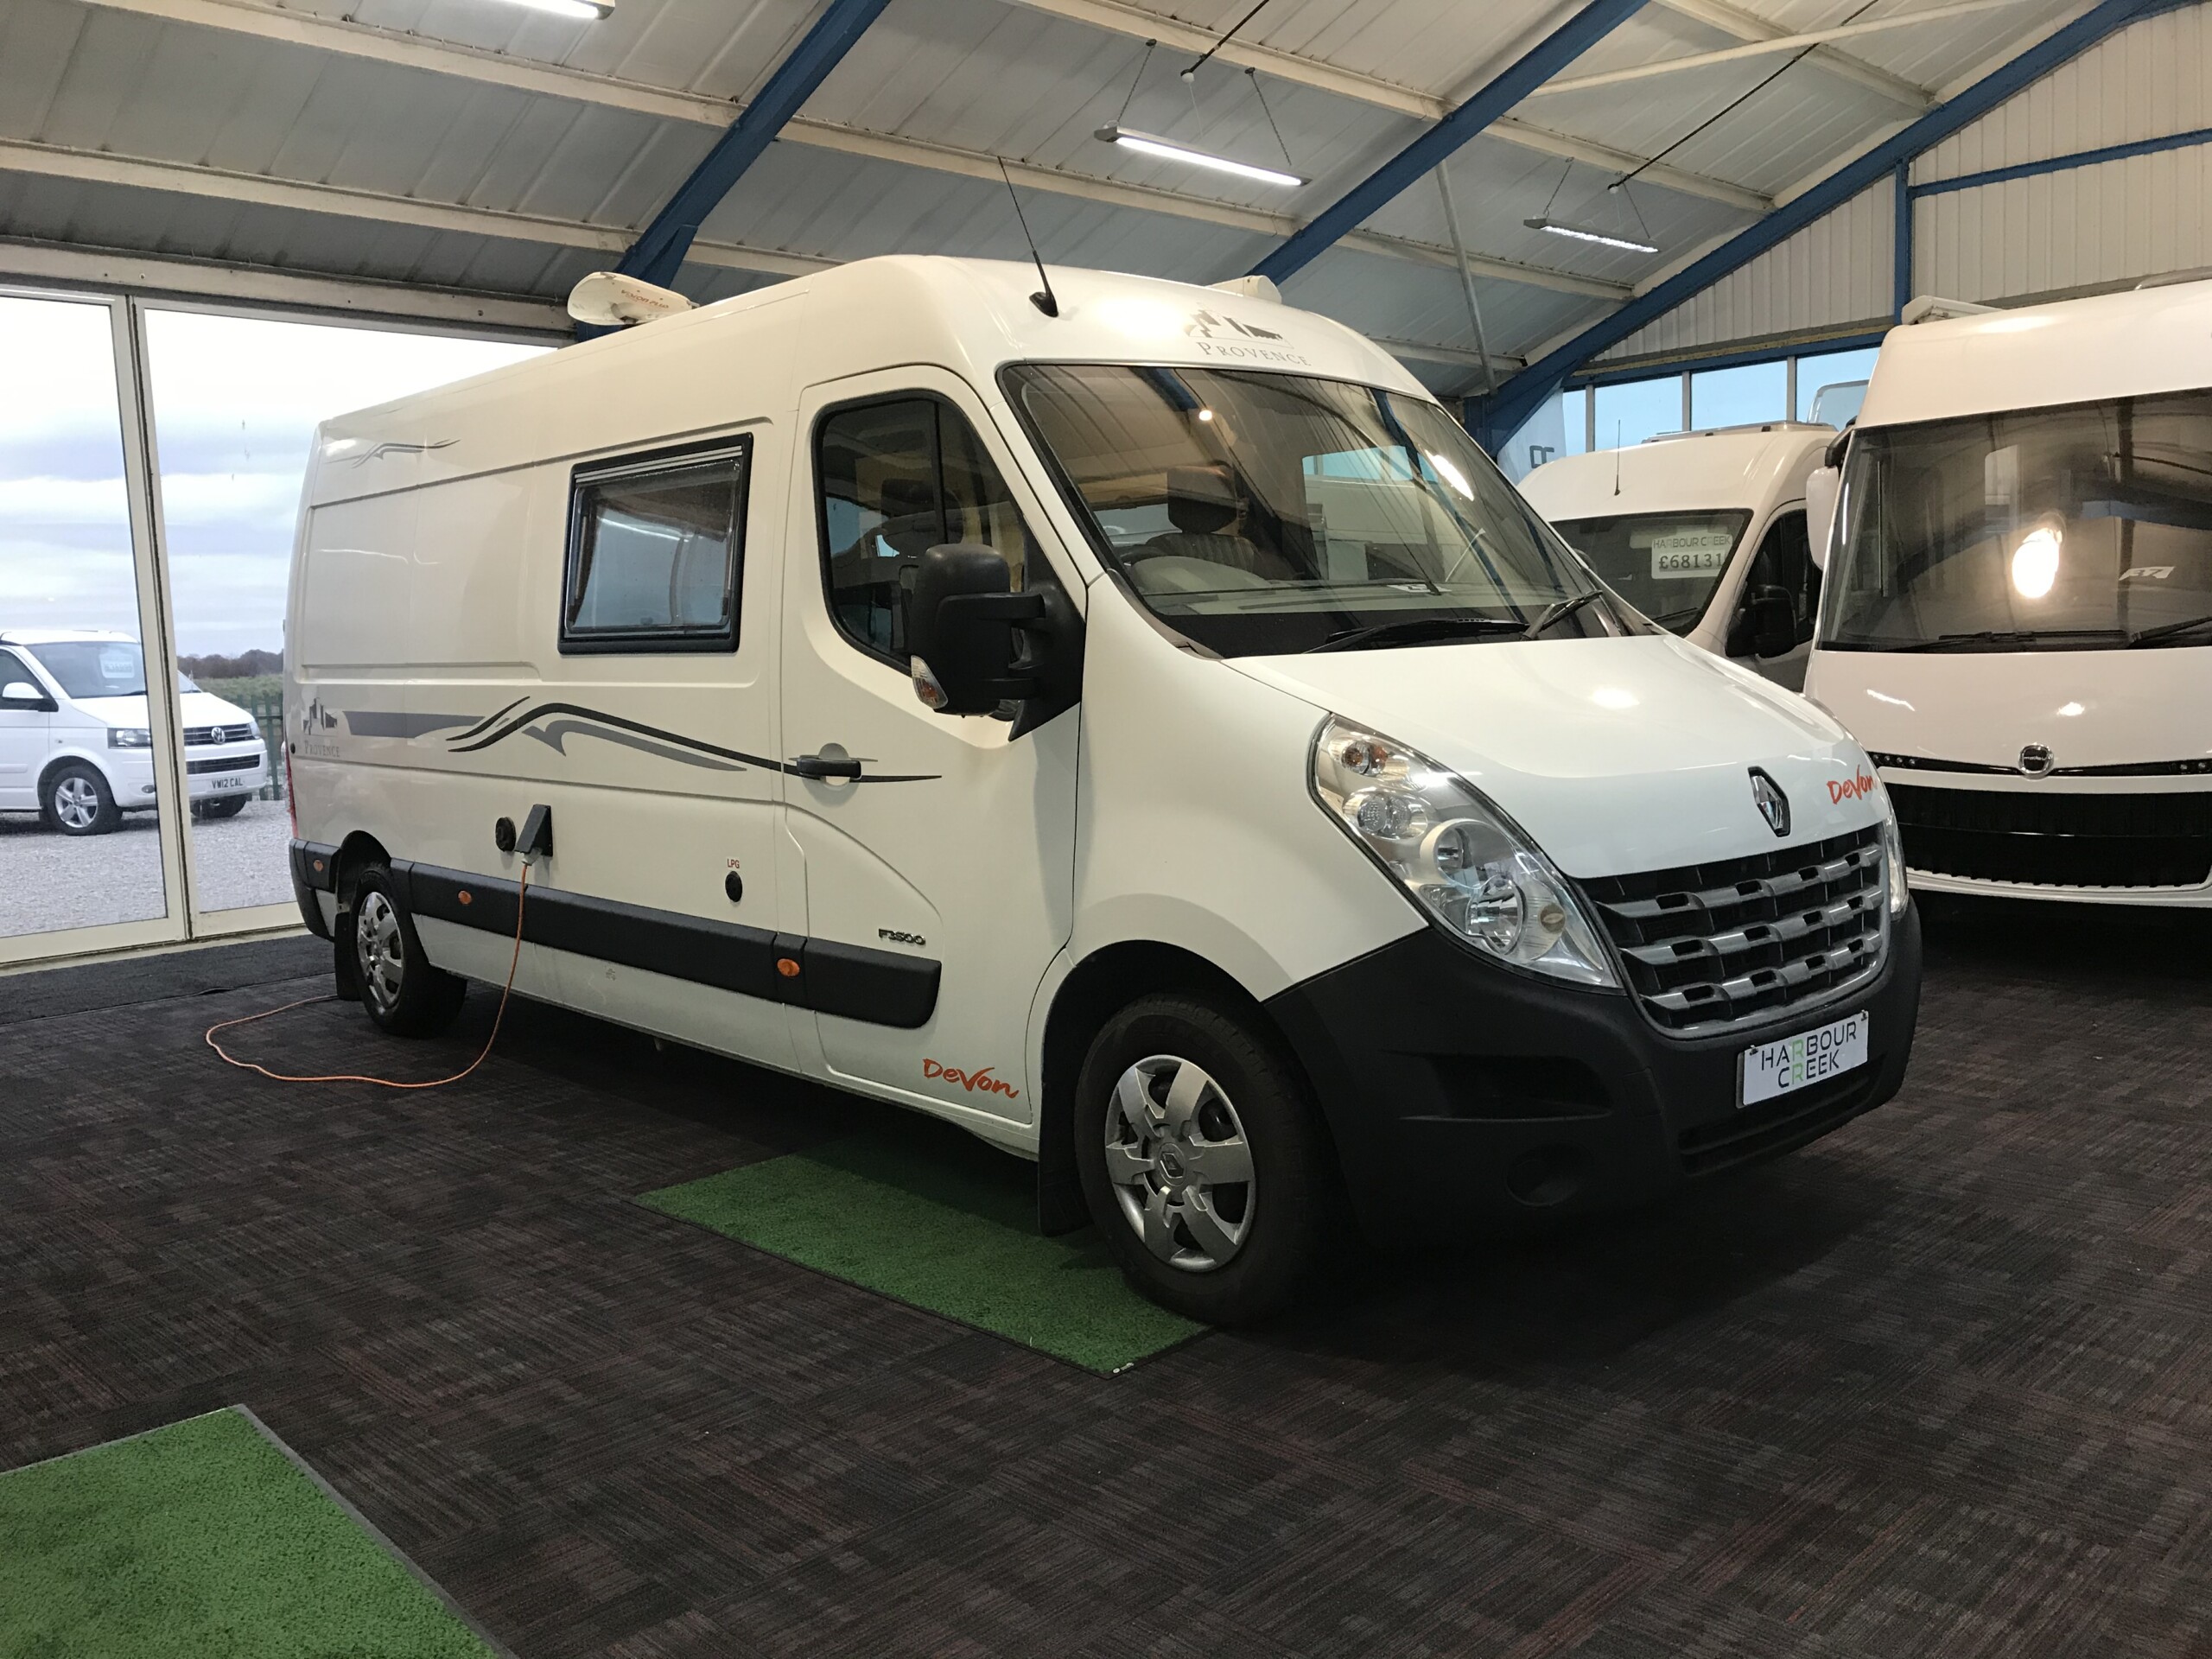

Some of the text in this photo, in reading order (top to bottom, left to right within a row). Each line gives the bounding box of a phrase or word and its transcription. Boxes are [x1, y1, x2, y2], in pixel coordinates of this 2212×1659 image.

[1196, 341, 1312, 366] PROVENCE
[304, 740, 340, 758] PROVENCE
[230, 777, 244, 787] CAL
[727, 858, 741, 869] LPG
[878, 928, 926, 946] F3500
[1761, 1020, 1857, 1071] HARBOUR
[1777, 1049, 1840, 1089] CREEK
